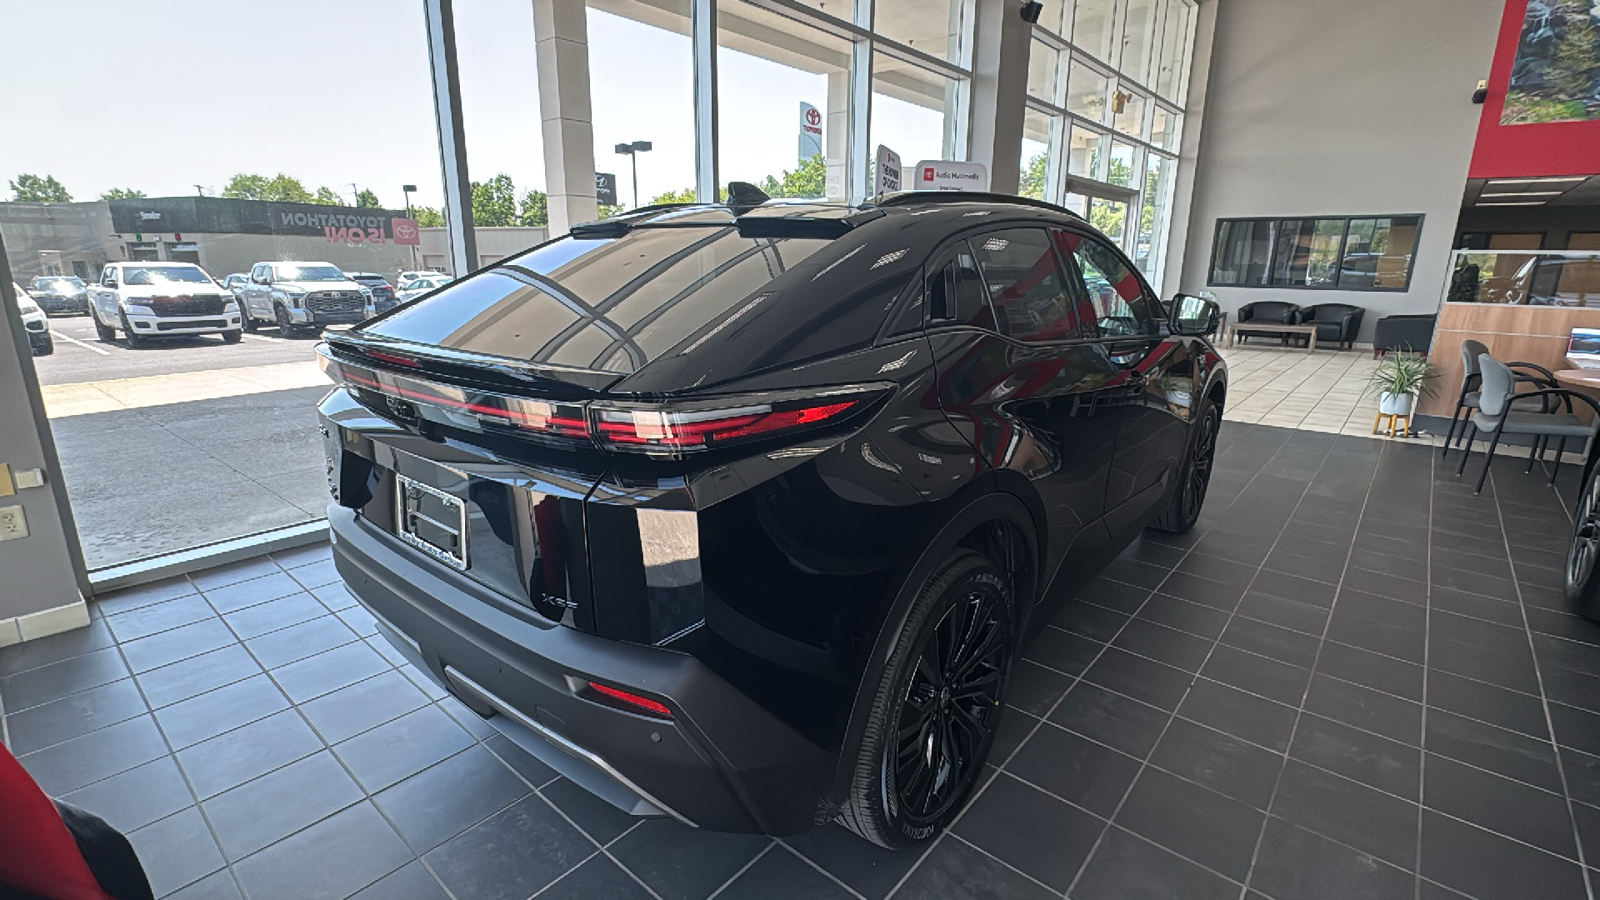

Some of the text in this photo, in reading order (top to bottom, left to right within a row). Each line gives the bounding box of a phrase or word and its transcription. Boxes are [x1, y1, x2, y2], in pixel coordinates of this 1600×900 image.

[936, 171, 979, 180] Audio Multimedia
[541, 592, 579, 609] XSE
